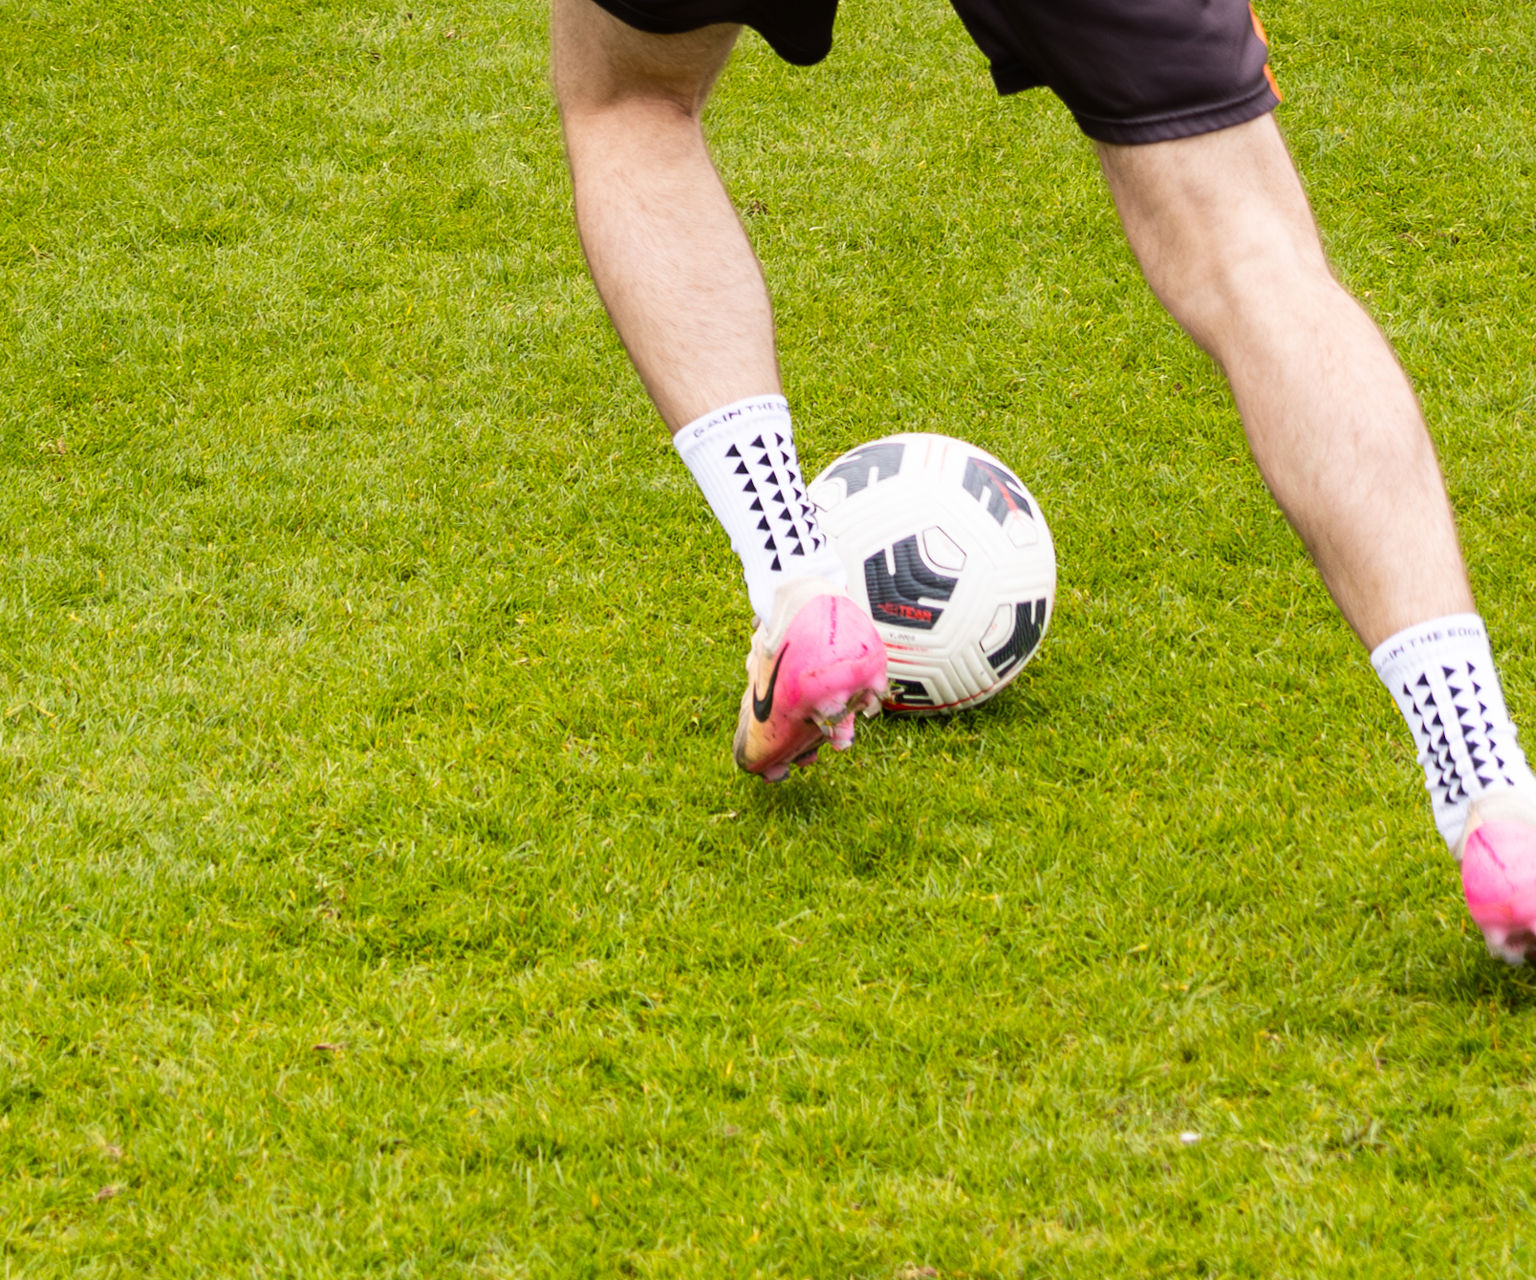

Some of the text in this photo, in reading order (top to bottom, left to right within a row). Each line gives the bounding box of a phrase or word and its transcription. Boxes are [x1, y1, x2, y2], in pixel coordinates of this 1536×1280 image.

[746, 401, 774, 413] THE
[899, 604, 933, 624] TEAM
[1409, 630, 1442, 648] THE
